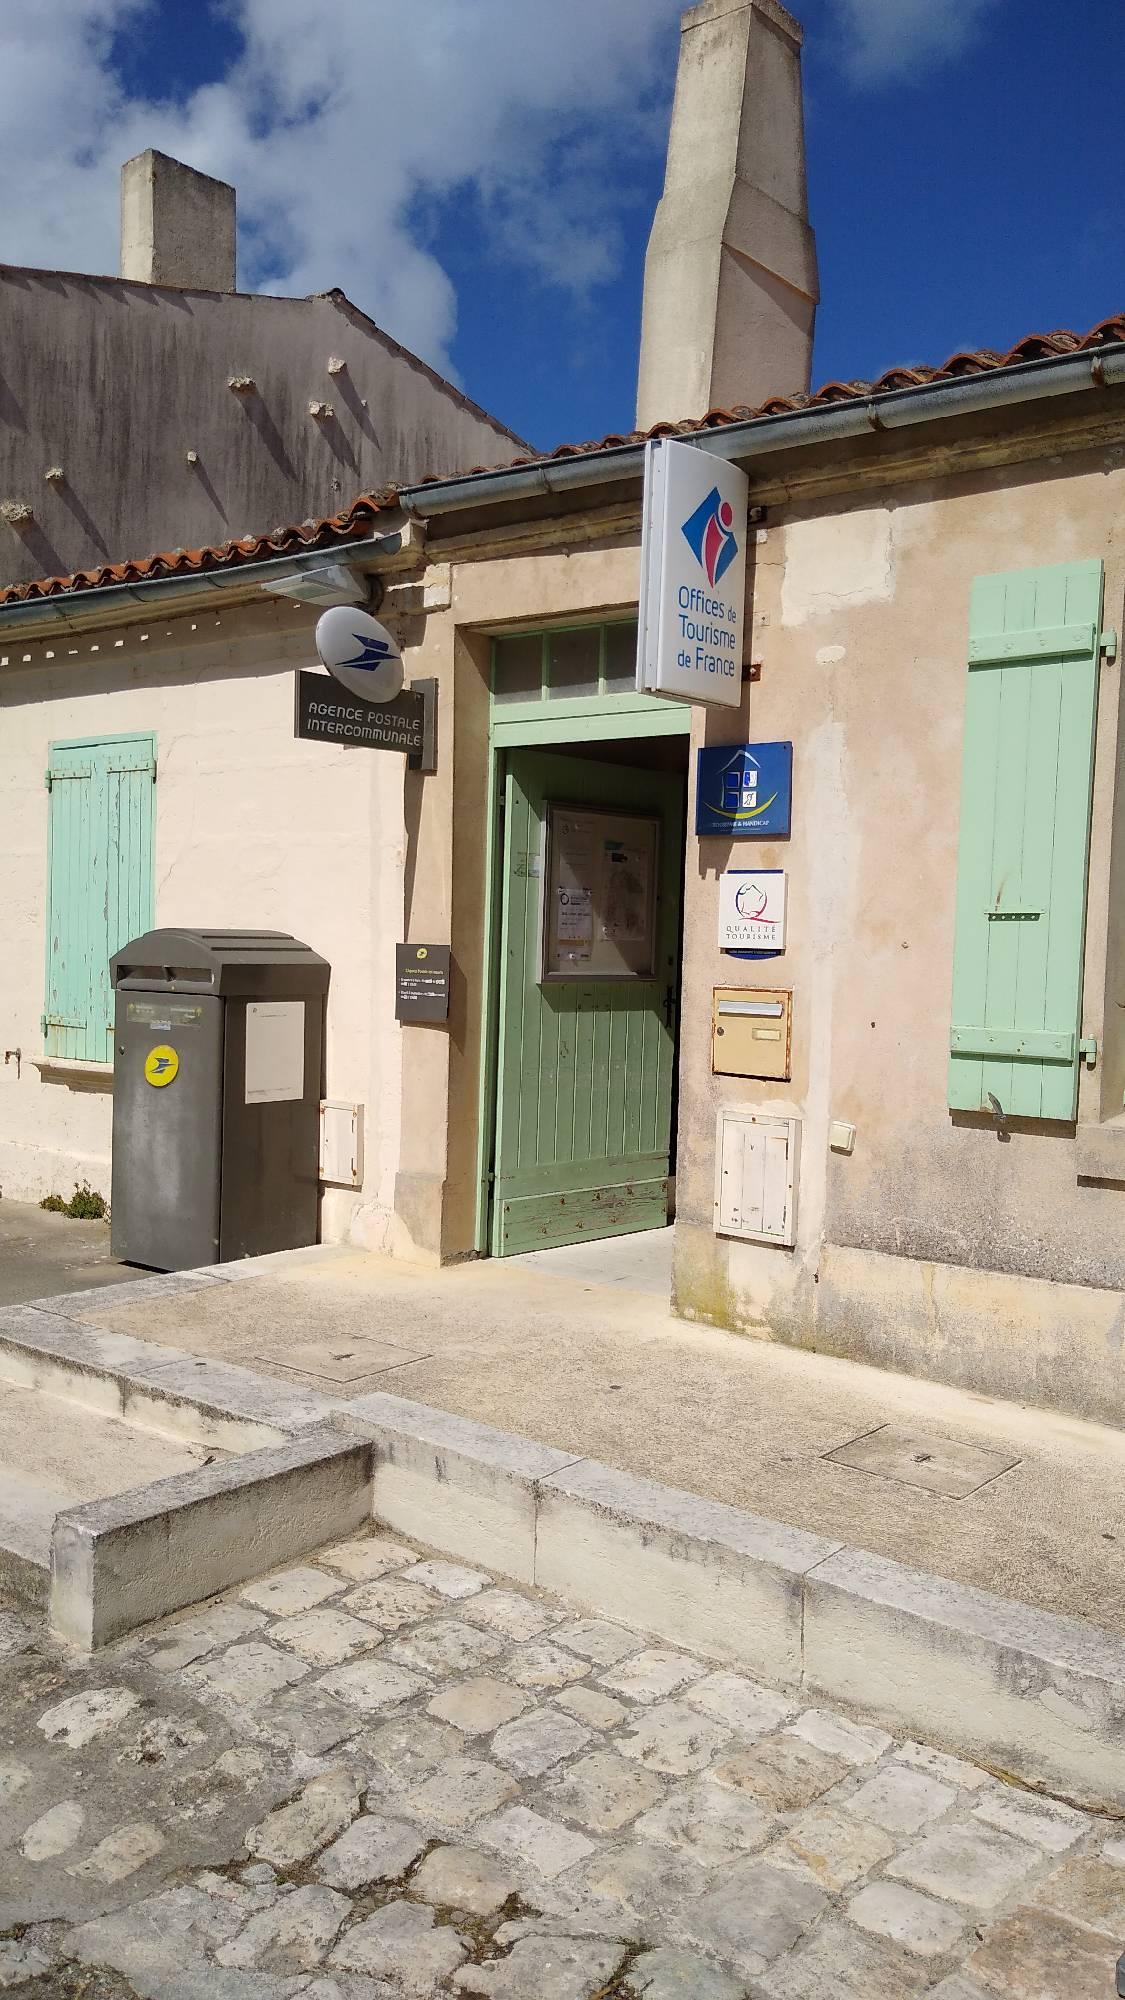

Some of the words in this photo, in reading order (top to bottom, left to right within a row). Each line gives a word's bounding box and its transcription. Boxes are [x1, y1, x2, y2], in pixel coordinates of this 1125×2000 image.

[678, 585, 725, 618] Offices
[727, 605, 737, 624] de
[678, 613, 736, 649] Tourisme
[677, 649, 691, 668] de
[695, 647, 735, 677] France
[309, 702, 364, 721] AGENCE
[367, 711, 421, 730] POSTALE
[307, 718, 421, 747] INTERCOMMUNALE
